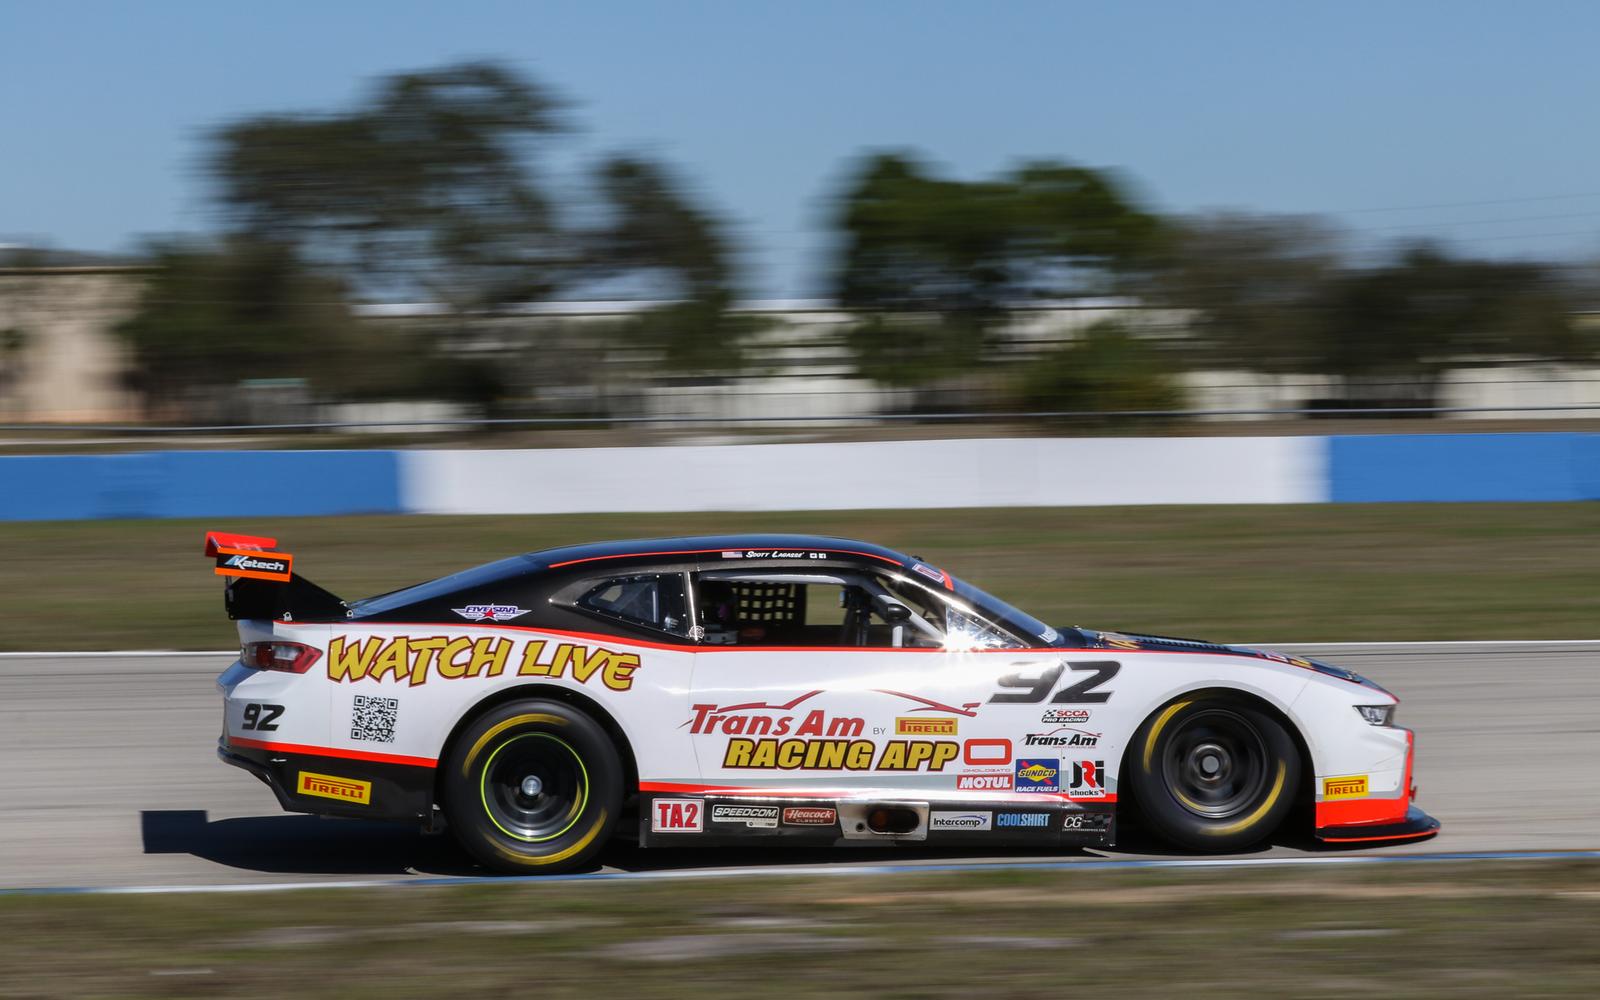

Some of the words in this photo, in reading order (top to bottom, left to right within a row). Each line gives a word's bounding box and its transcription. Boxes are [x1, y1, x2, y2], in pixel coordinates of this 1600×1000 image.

[224, 555, 284, 571] Katech
[327, 635, 512, 687] WATCH
[517, 639, 642, 692] LIVE
[987, 660, 1121, 704] 92
[241, 703, 285, 732] 92
[689, 703, 792, 736] Trans
[794, 709, 866, 737] Am
[873, 727, 887, 735] BY
[899, 719, 954, 734] PIRELLI
[1025, 733, 1067, 746] Trans
[1068, 733, 1098, 746] Am
[721, 737, 875, 772] RACING
[874, 738, 960, 772] APP
[1019, 769, 1055, 778] SUNOCO
[303, 776, 364, 800] PIRELLI
[959, 776, 1011, 789] MOTUL
[1016, 785, 1036, 793] RACE
[1036, 785, 1058, 793] FUELS
[1325, 779, 1365, 795] PIRELLI
[1070, 789, 1098, 797] shocks
[658, 803, 699, 828] TA2
[787, 809, 833, 819] Heacock
[997, 813, 1051, 827] COOLSHIRT
[933, 818, 981, 828] Intercomp
[1064, 816, 1083, 828] CG
